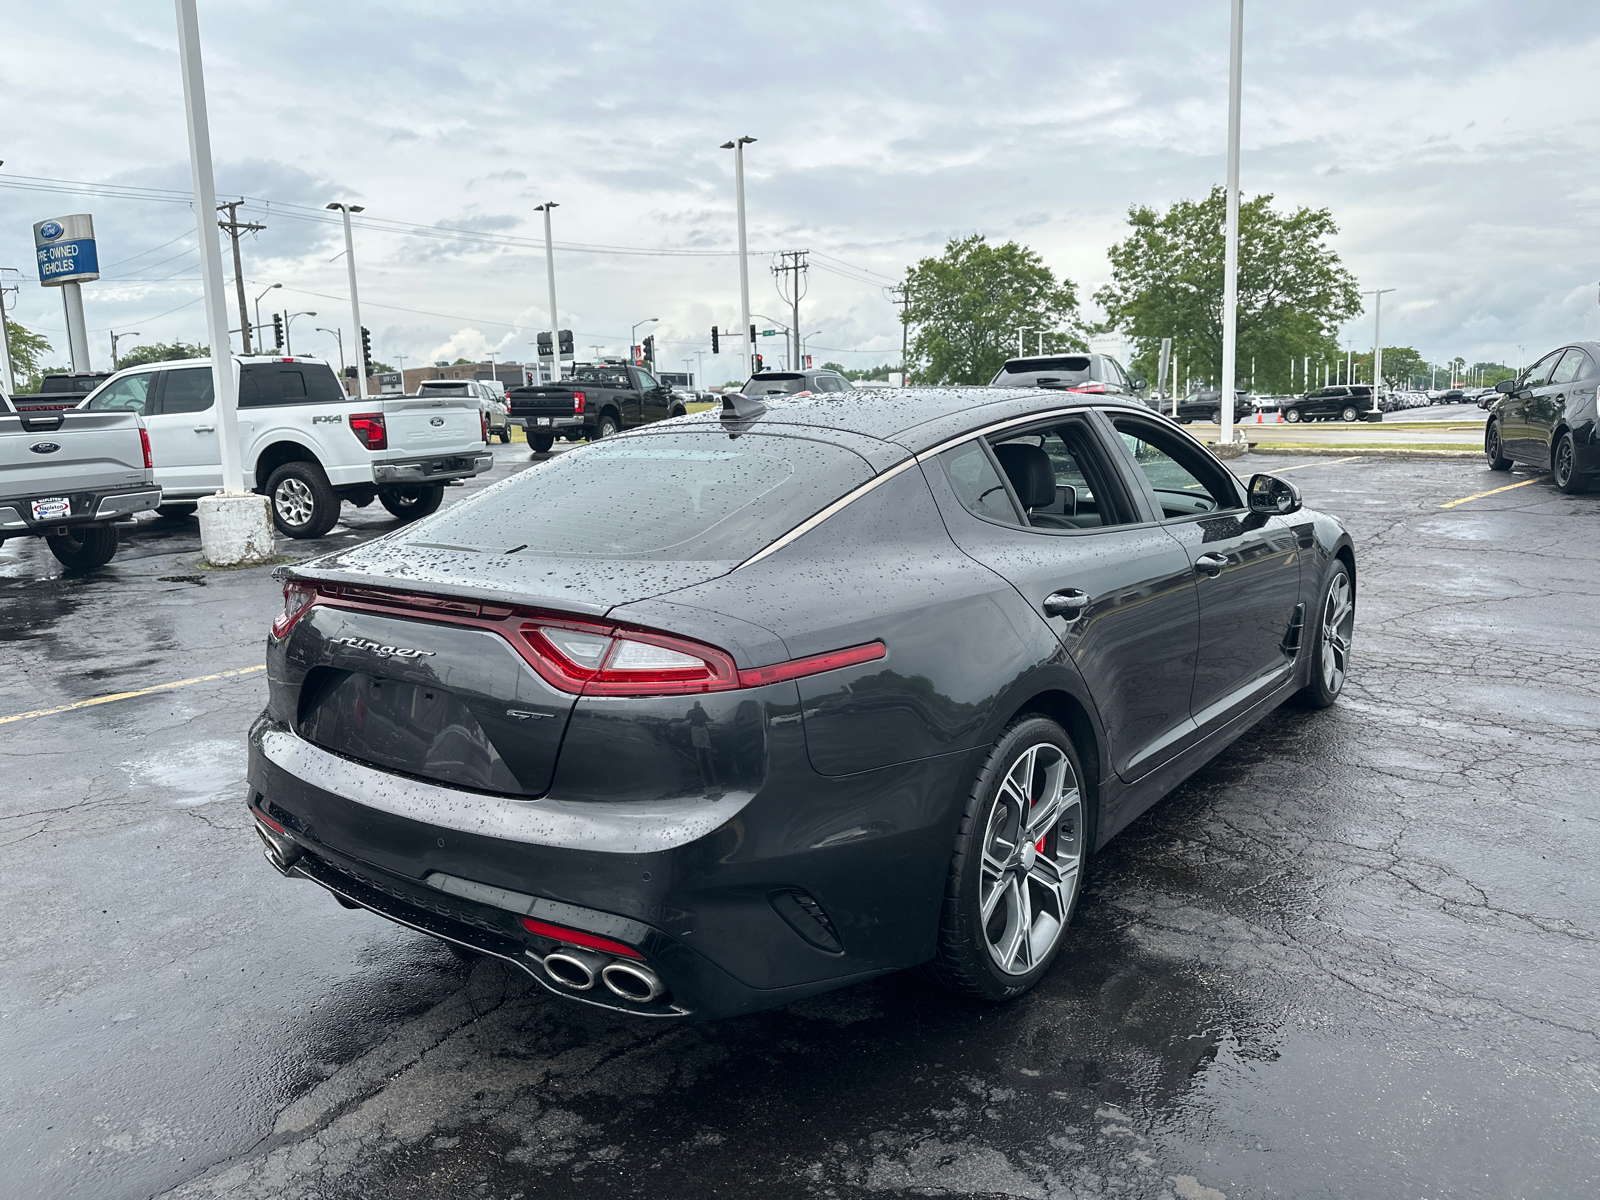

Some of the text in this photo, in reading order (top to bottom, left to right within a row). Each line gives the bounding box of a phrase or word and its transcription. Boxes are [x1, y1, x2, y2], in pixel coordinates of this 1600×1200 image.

[37, 244, 79, 263] PRE-OWNED
[41, 259, 75, 276] VEHICLES
[312, 414, 342, 425] FX4
[39, 504, 64, 512] Napleton
